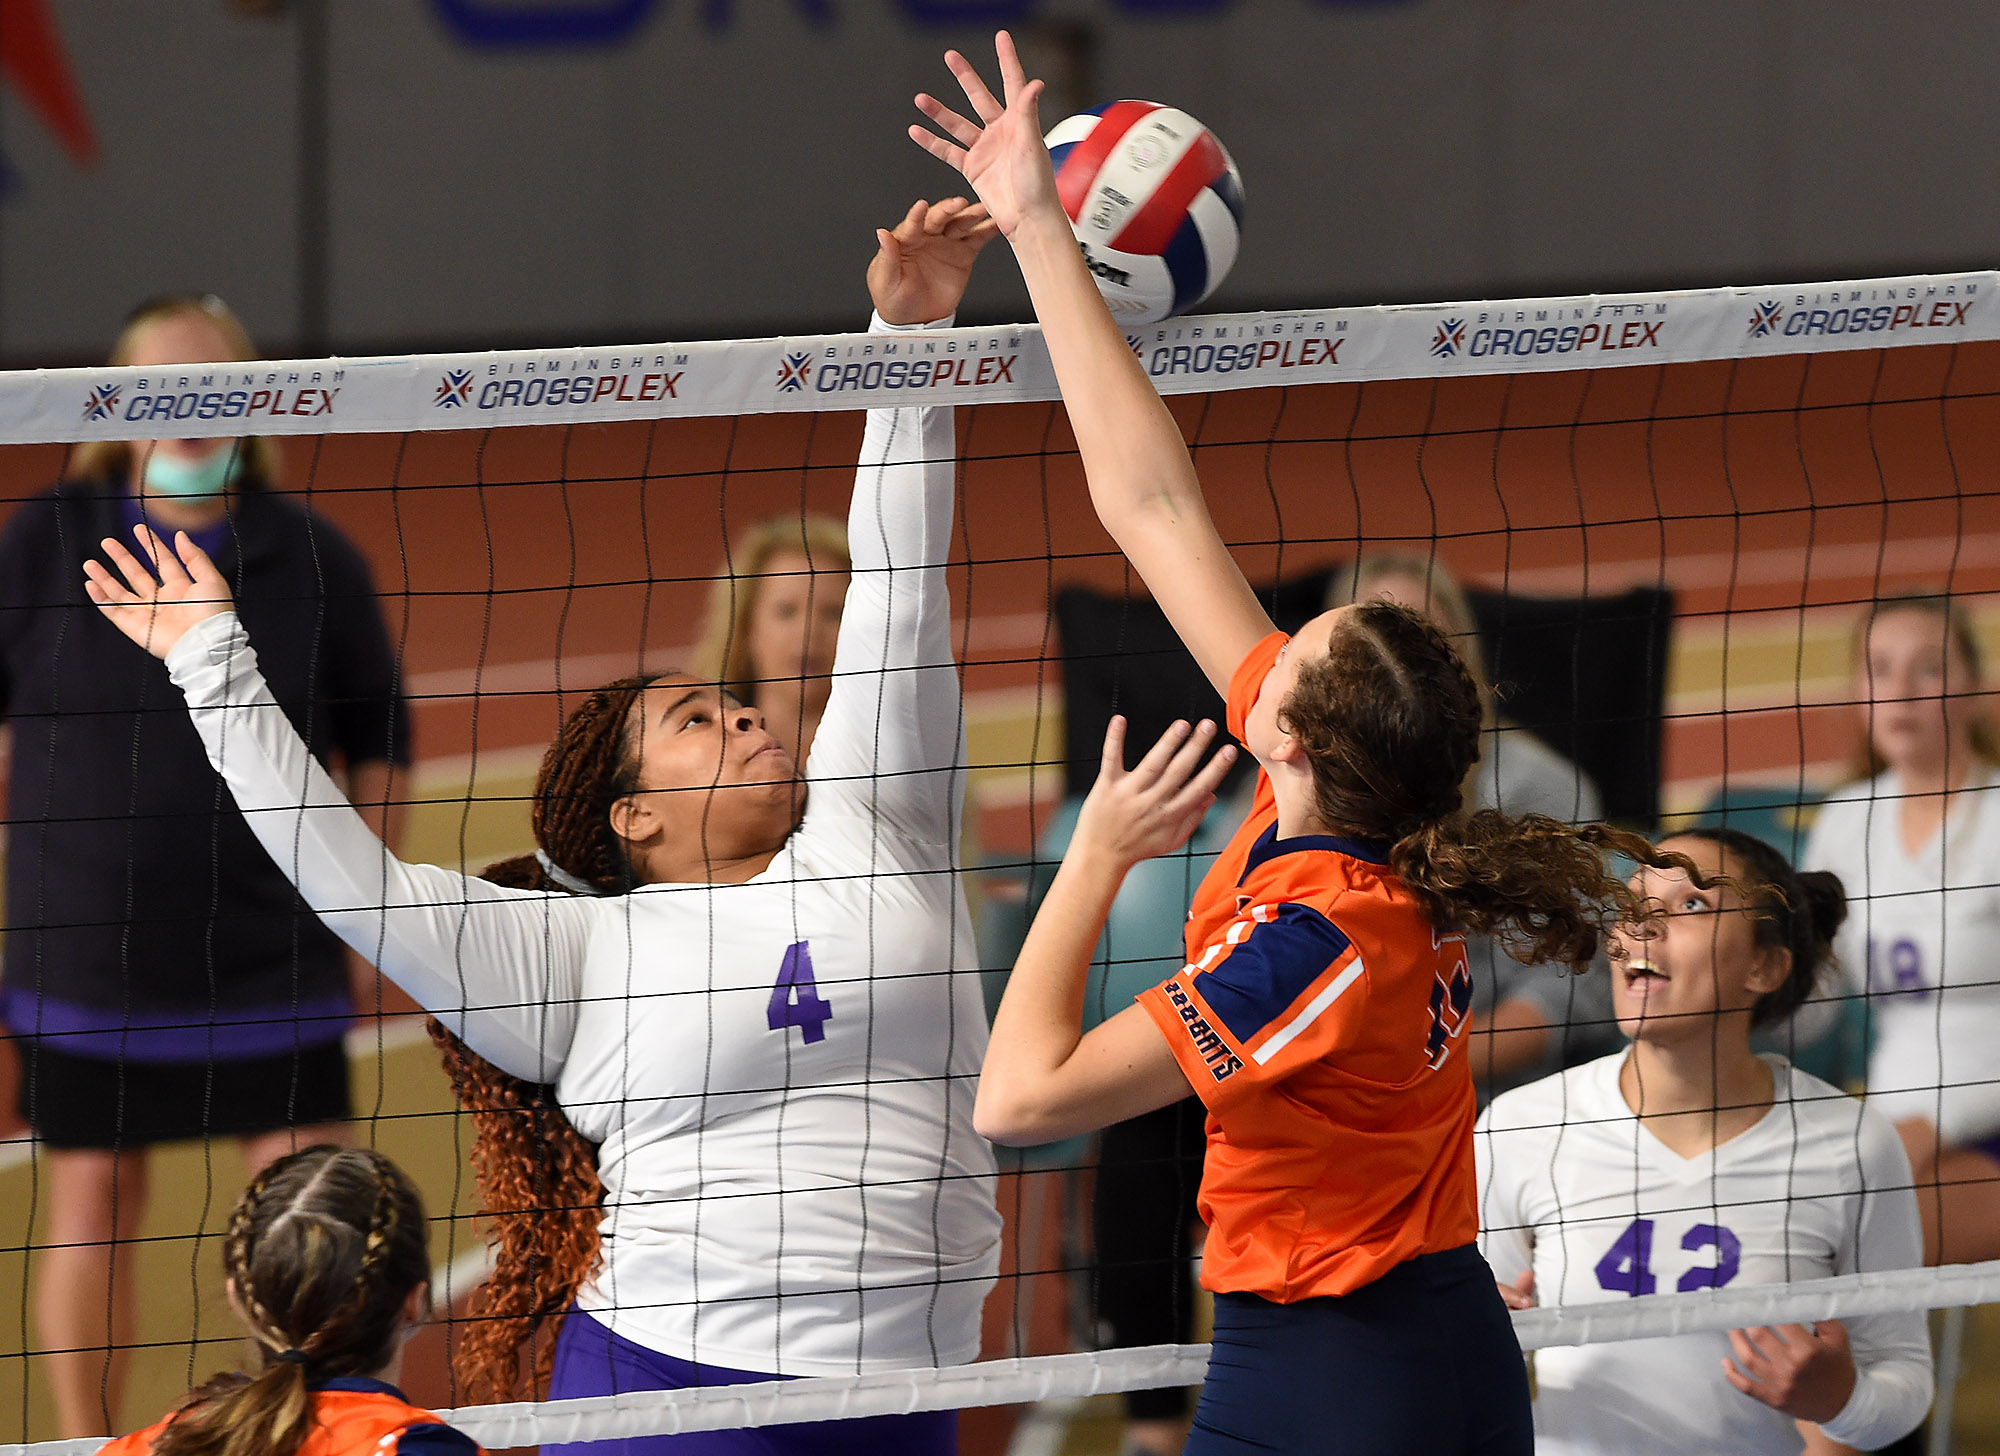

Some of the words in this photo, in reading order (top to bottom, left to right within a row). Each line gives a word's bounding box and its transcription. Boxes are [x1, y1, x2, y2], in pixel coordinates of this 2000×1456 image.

[1796, 284, 1977, 305] BIRMINGHAM
[1157, 320, 1348, 341] BIRMINGHAM
[1783, 301, 1974, 337] CROSSPLEX
[825, 337, 1022, 358] BIRMINGHAM
[1150, 338, 1346, 376] CROSSPLEX
[1468, 321, 1665, 357] CROSSPLEX
[137, 370, 345, 390] BIRMINGHAM
[488, 354, 688, 376] BIRMINGHAM
[815, 354, 1018, 393] CROSSPLEX
[124, 387, 341, 422] CROSSPLEX
[477, 371, 685, 410] CROSSPLEX
[767, 940, 833, 1045] 4
[1595, 1219, 1741, 1297] 42
